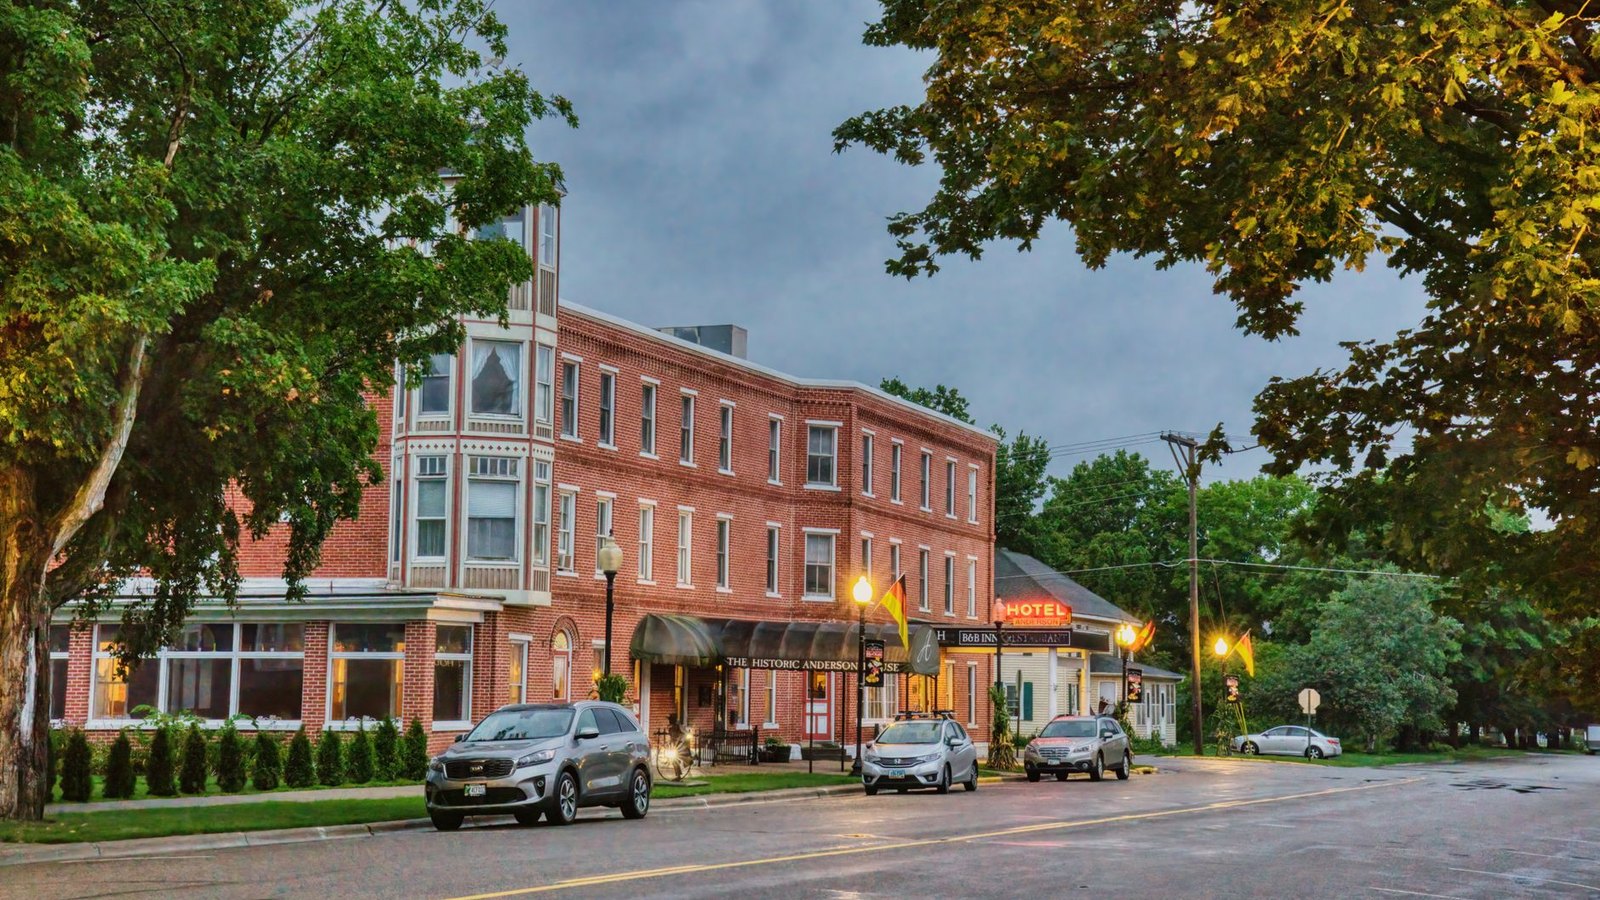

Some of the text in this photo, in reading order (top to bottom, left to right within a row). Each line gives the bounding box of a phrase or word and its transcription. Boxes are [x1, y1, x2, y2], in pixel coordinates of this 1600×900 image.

[1007, 604, 1066, 616] HOTEL
[962, 633, 1068, 643] B&B INN ESTAURANT
[727, 657, 748, 667] THE
[752, 658, 801, 669] HISTORIC
[802, 660, 859, 671] ANDERSON
